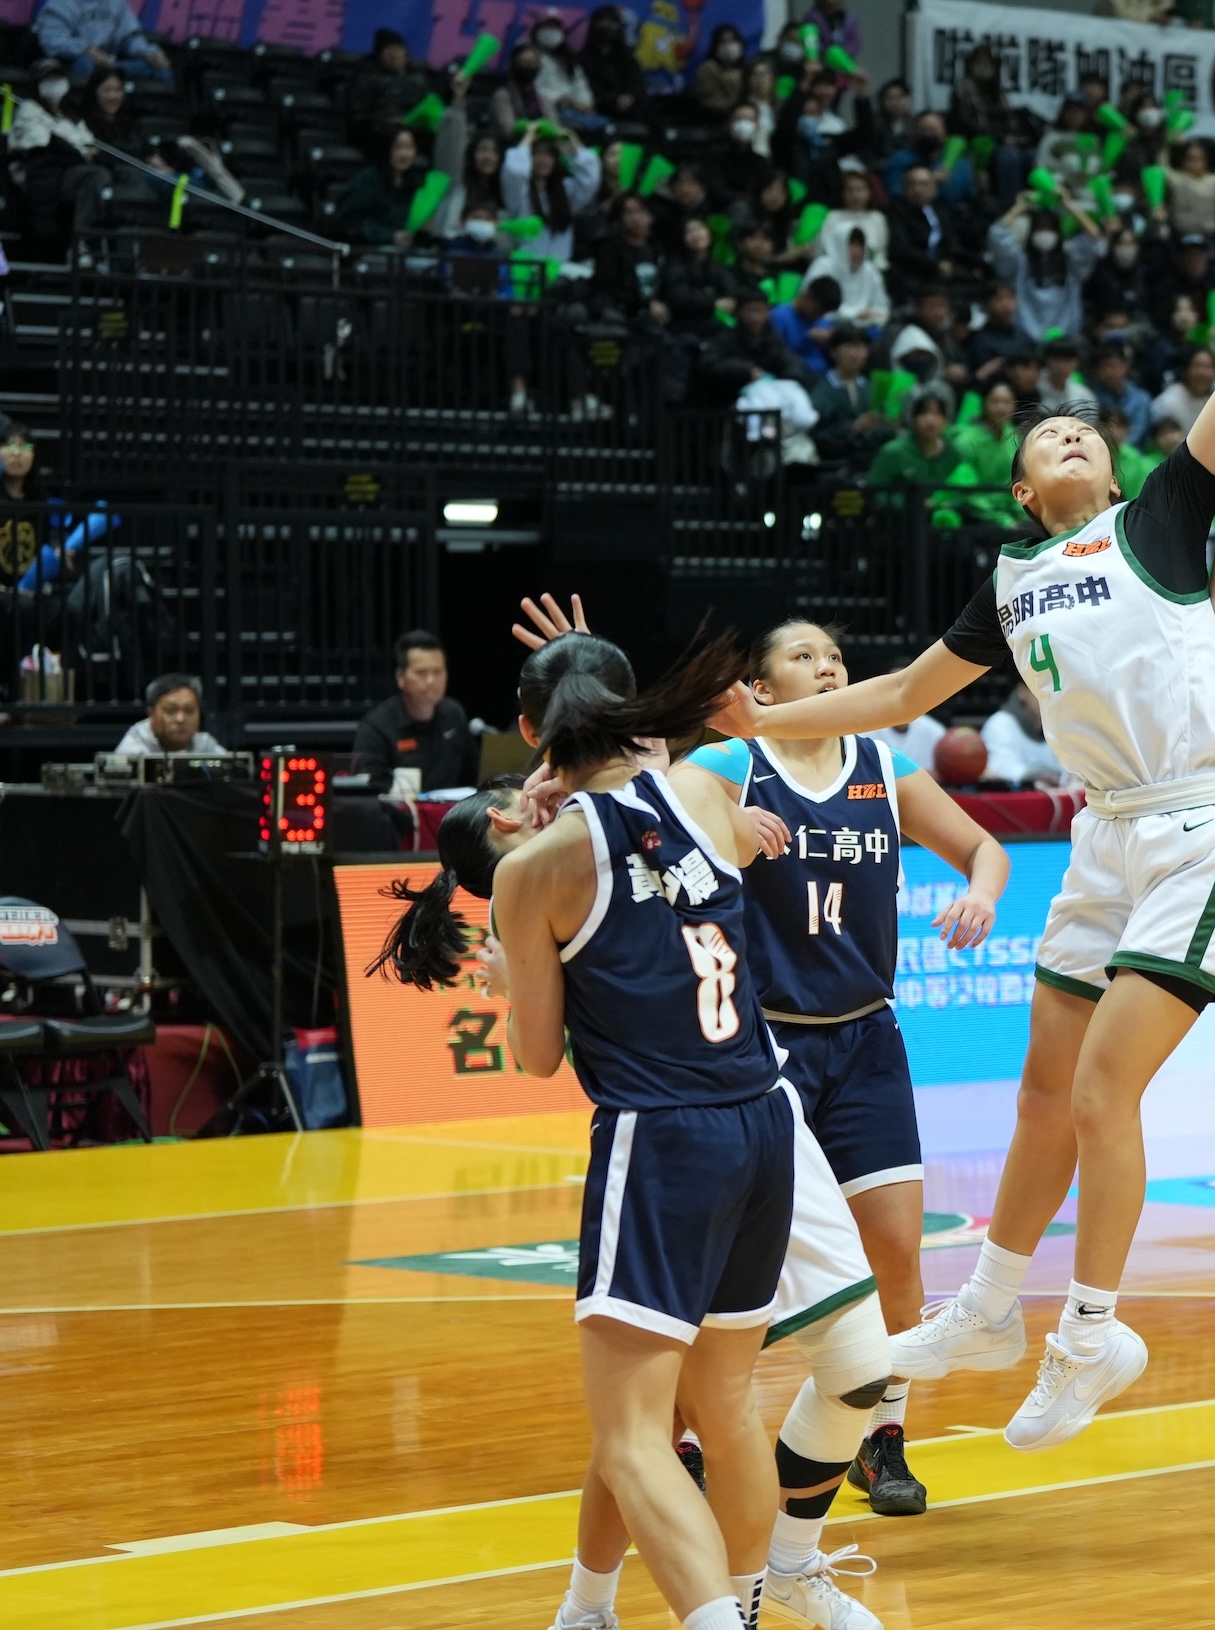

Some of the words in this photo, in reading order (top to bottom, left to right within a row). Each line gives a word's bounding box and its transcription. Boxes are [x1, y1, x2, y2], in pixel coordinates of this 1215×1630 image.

[1029, 633, 1062, 692] 4
[786, 825, 889, 865] 仁高中
[806, 880, 844, 936] 14
